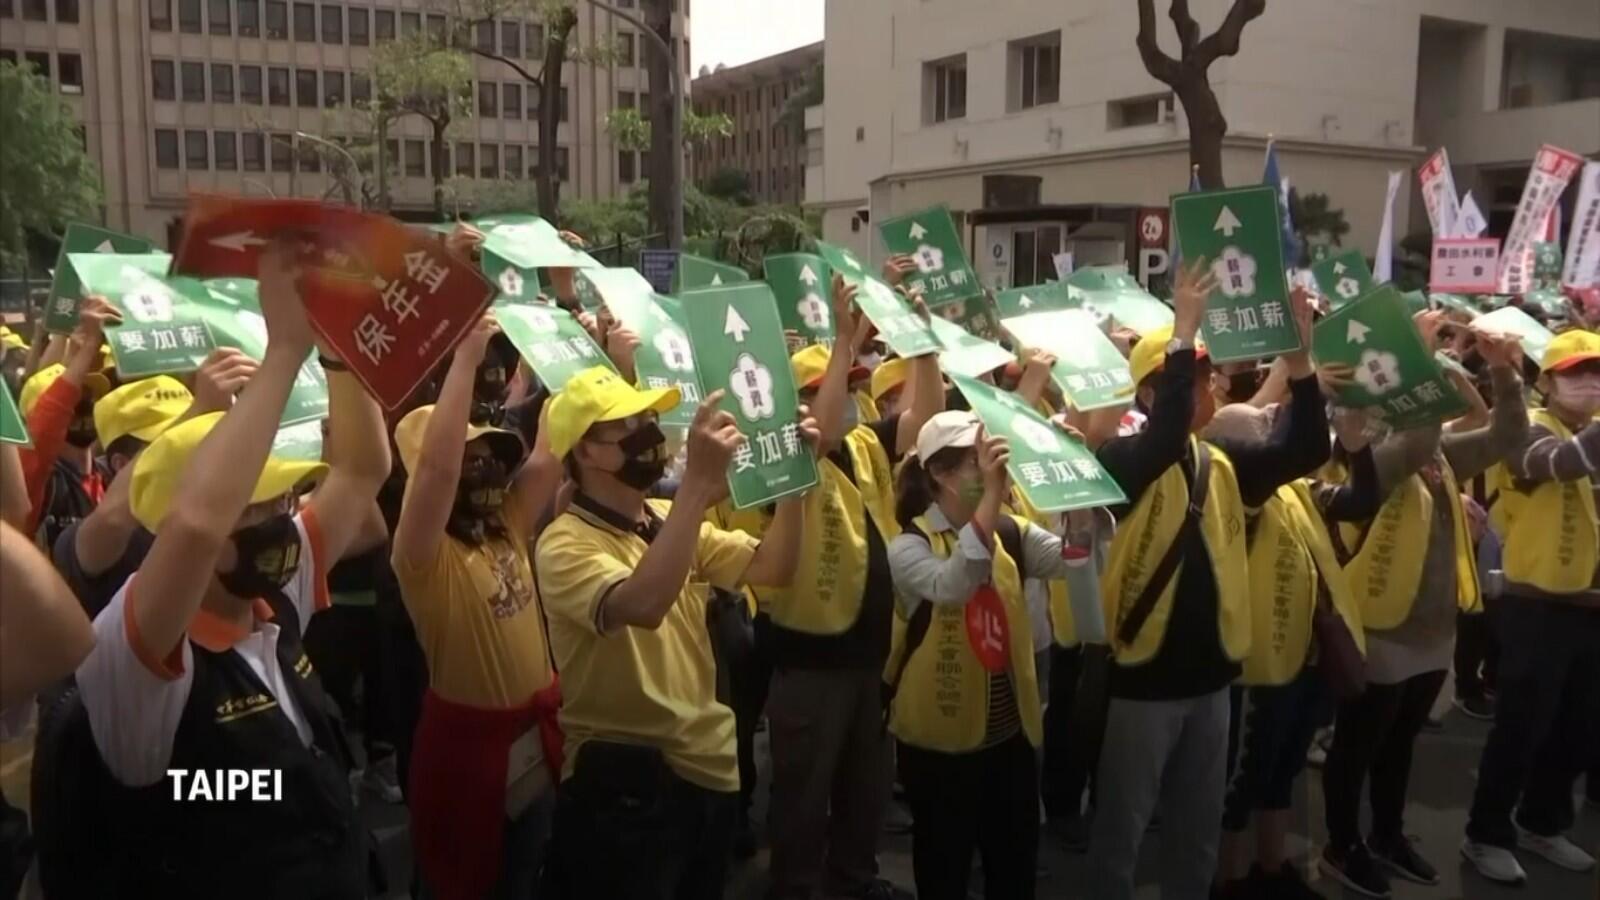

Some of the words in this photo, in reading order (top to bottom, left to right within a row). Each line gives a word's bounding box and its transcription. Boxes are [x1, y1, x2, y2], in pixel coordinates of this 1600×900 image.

[1139, 248, 1169, 288] P
[353, 250, 450, 366] 保年金
[1206, 300, 1286, 335] 要加薪
[118, 324, 207, 354] 要加薪
[1018, 456, 1102, 488] 要加薪
